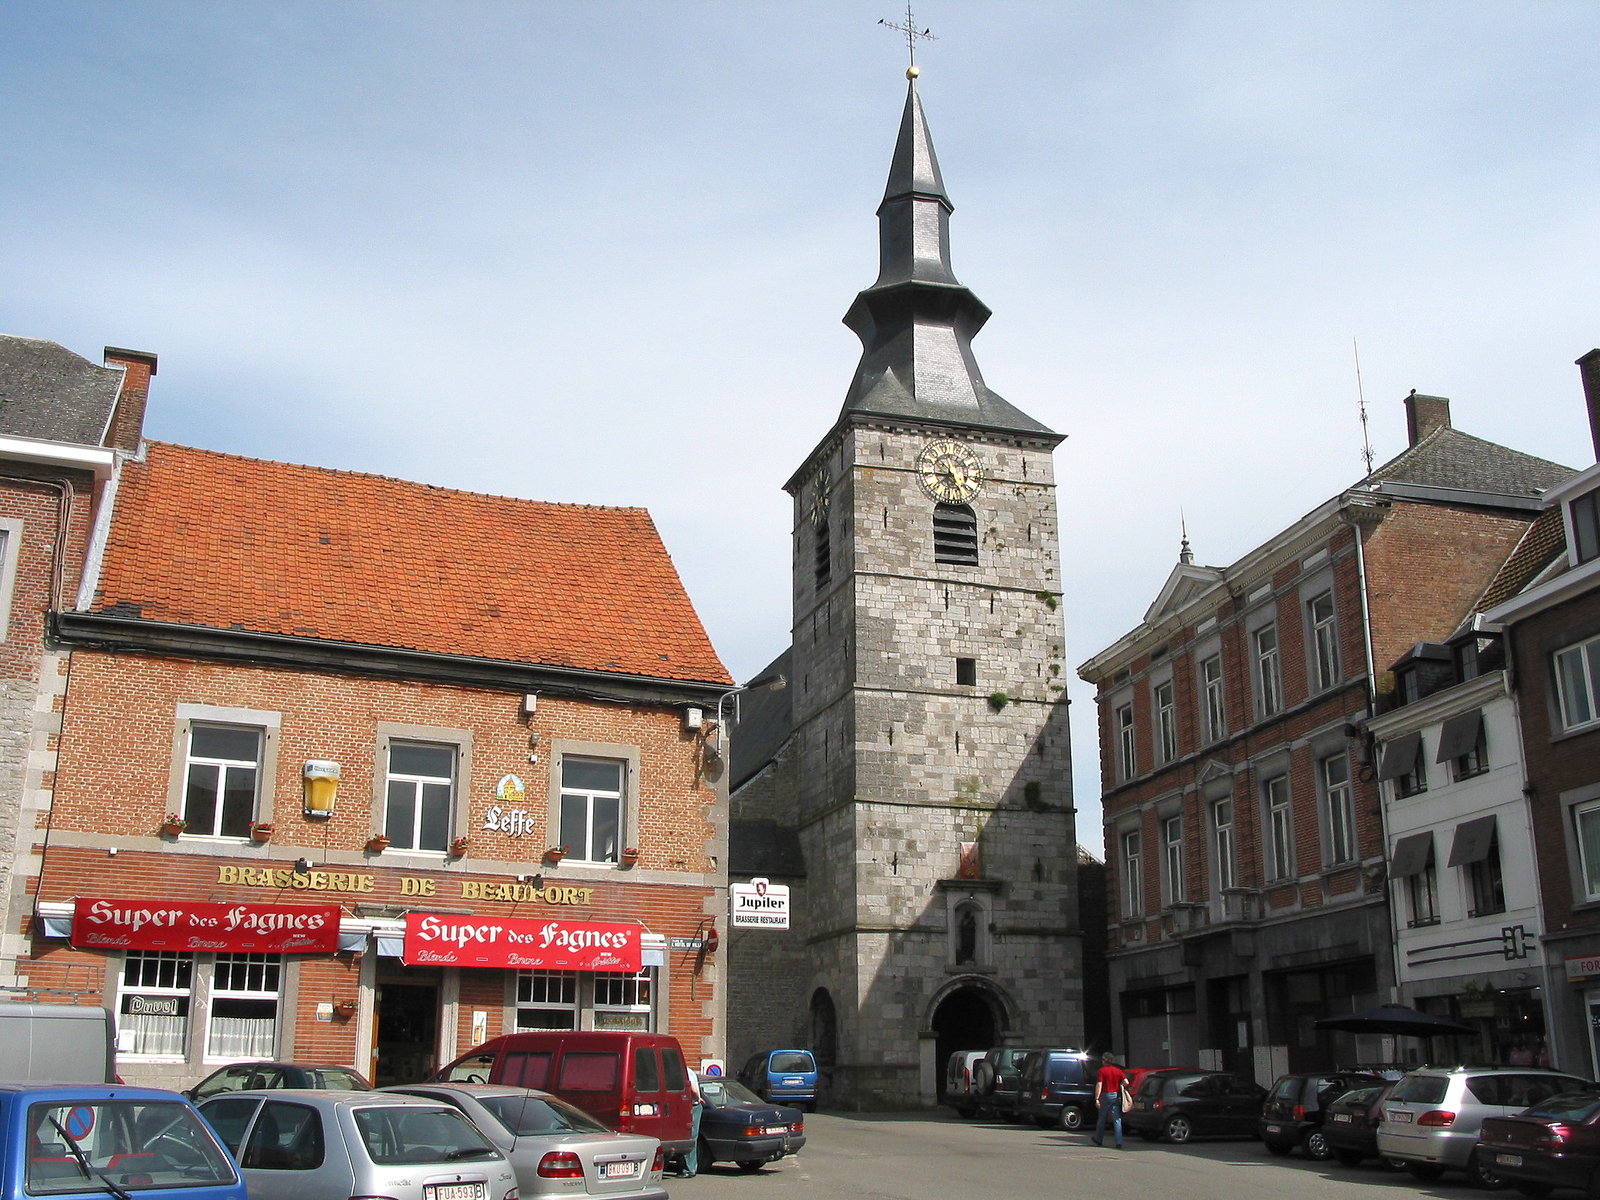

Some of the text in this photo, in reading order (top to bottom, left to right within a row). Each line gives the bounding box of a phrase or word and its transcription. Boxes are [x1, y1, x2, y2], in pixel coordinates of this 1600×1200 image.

[481, 806, 535, 838] Leffe
[217, 865, 594, 905] BRASSERIE DE BEAUFORT
[739, 896, 785, 910] Jupiler
[86, 900, 184, 932] Super
[189, 913, 219, 927] des
[736, 915, 786, 924] BRASSERIE RESTAURANT
[86, 932, 131, 945] Blonde
[187, 936, 228, 949] Brune
[416, 916, 503, 948] Super
[508, 929, 534, 944] des
[417, 950, 457, 962] Blonde
[507, 953, 544, 965] Brune
[131, 996, 177, 1014] Duvel
[475, 1184, 482, 1198] B
